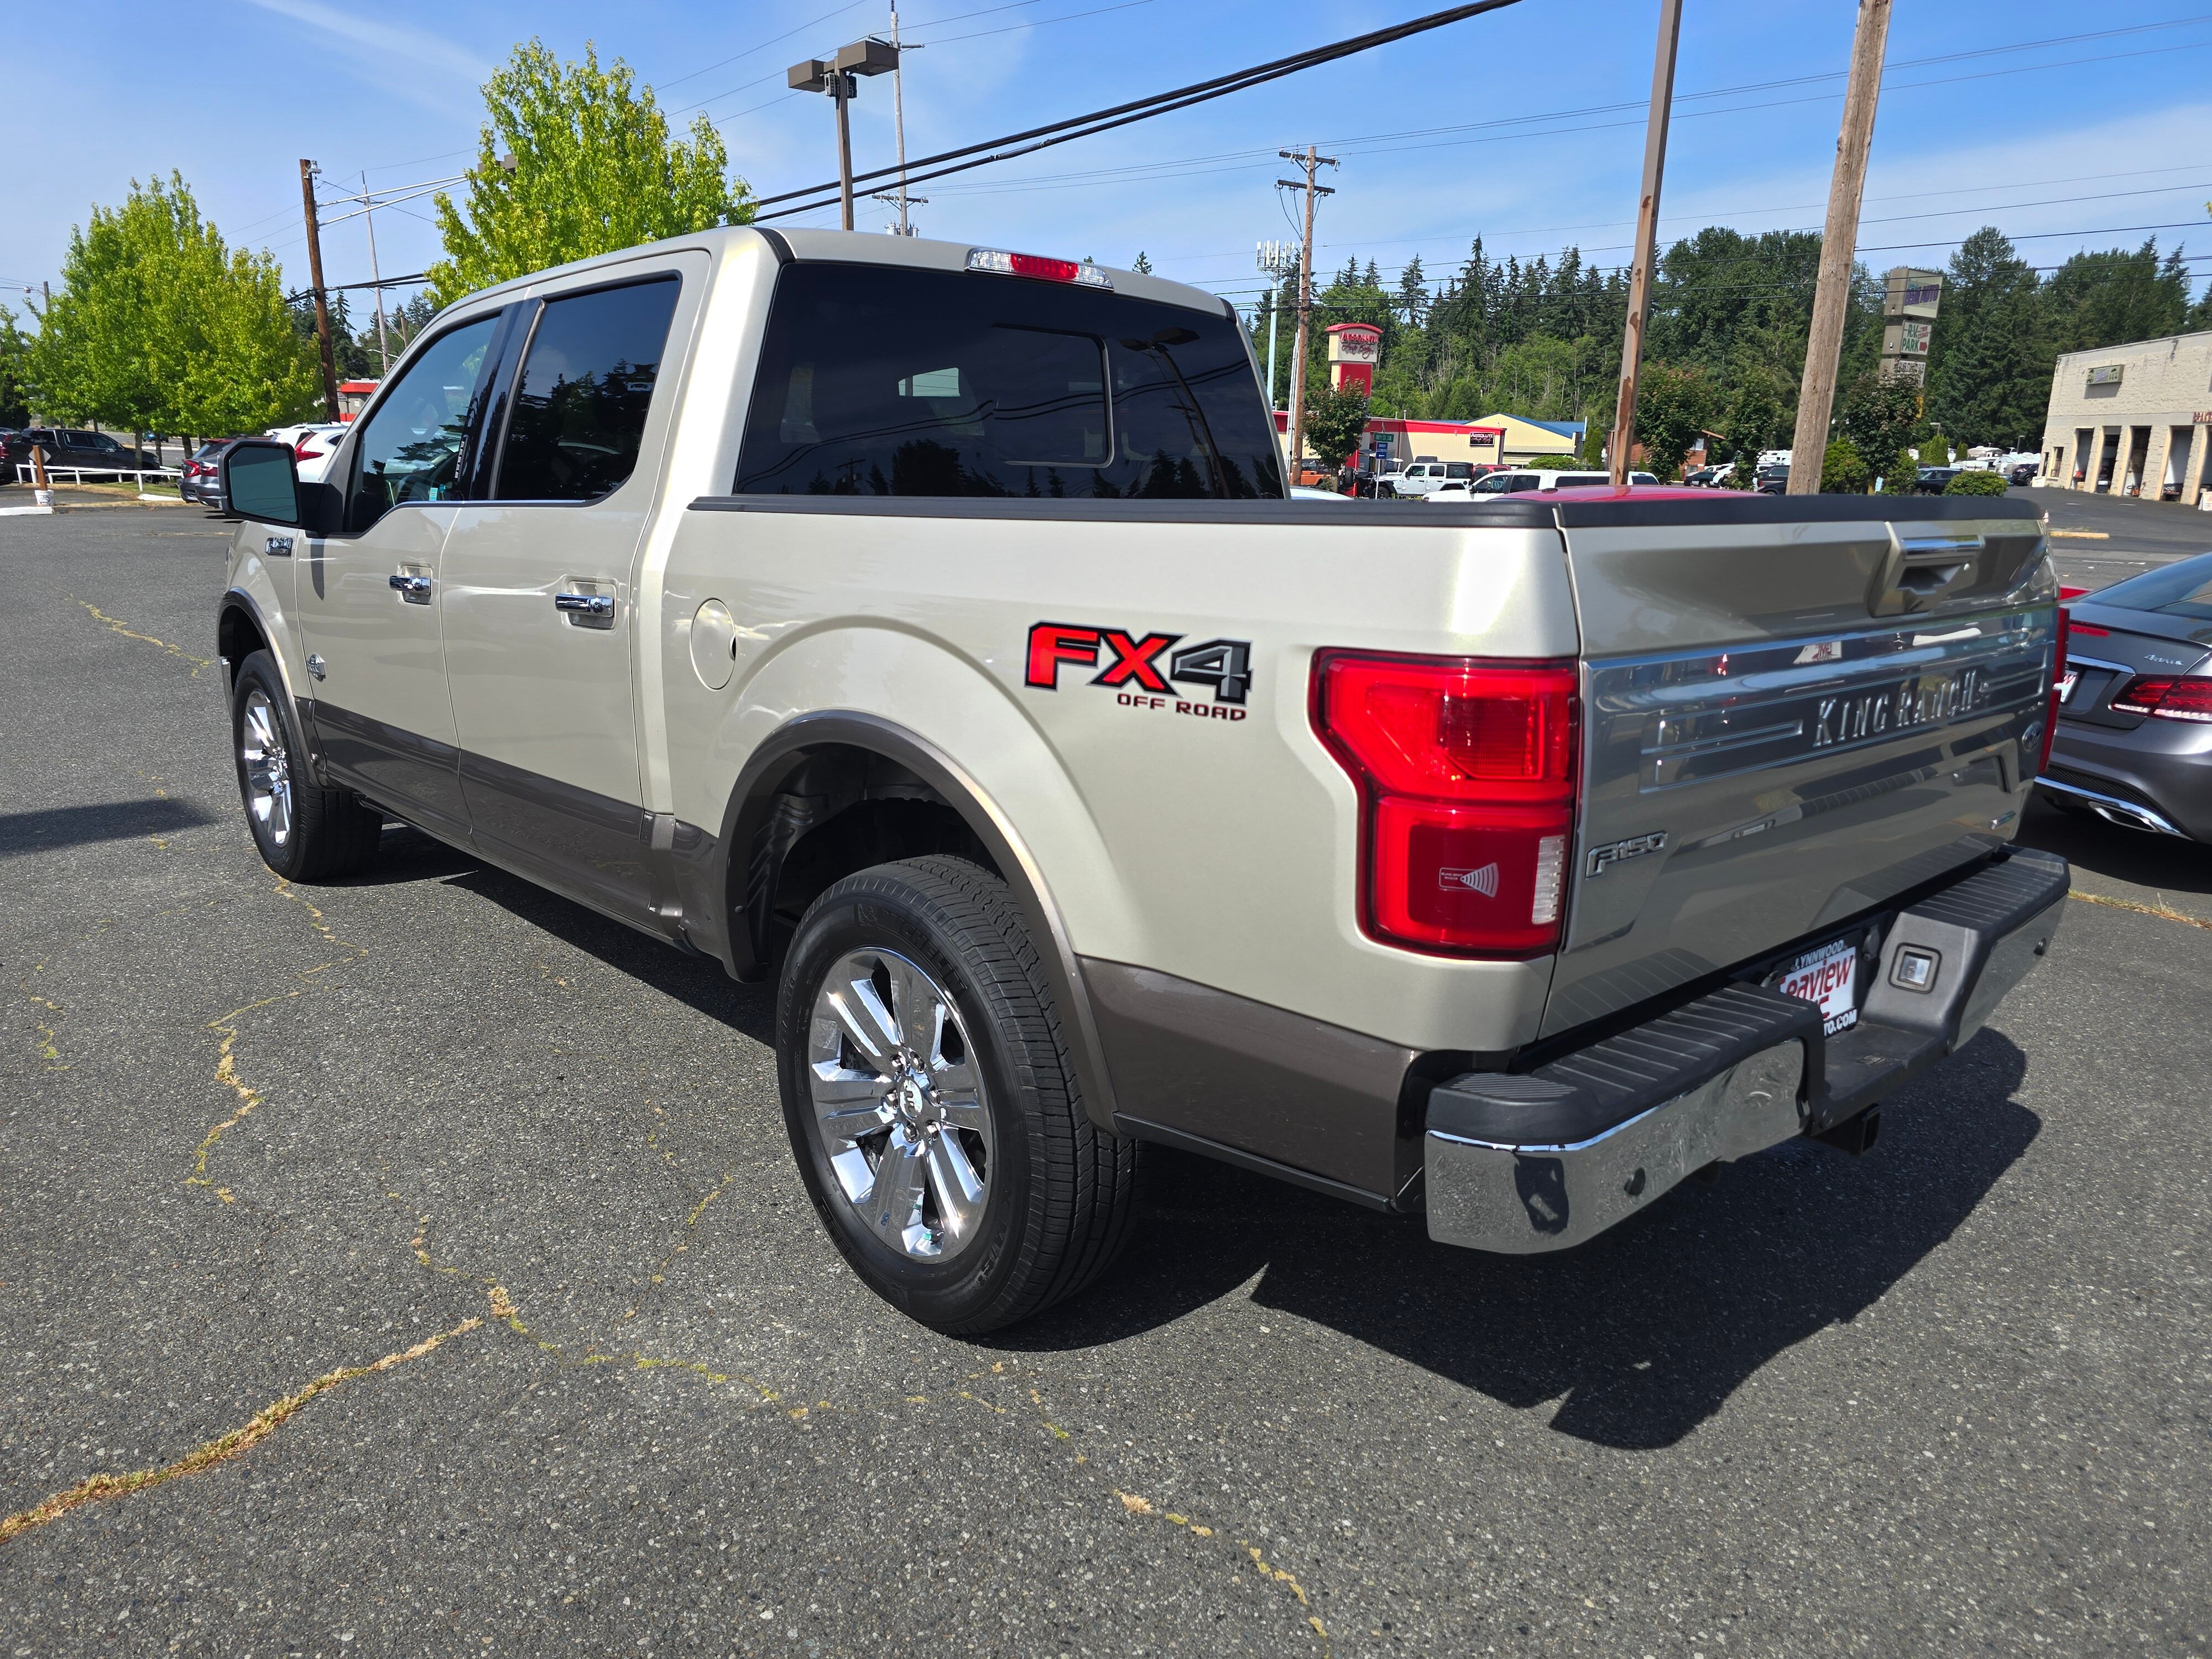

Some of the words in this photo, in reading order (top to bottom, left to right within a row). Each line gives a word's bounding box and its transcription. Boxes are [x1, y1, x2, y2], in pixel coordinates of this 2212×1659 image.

[1340, 332, 1378, 343] ABSOLUTE
[1902, 338, 1919, 352] PARK
[1024, 620, 1254, 707] FX4
[1117, 693, 1165, 710] OFF
[1176, 700, 1246, 721] ROAD
[1813, 696, 1889, 747] KING
[1895, 670, 1977, 728] RANCH
[1795, 940, 1844, 968] LYNNWOOD
[1779, 955, 1854, 999] eaview
[1824, 1009, 1857, 1036] TO.COM
